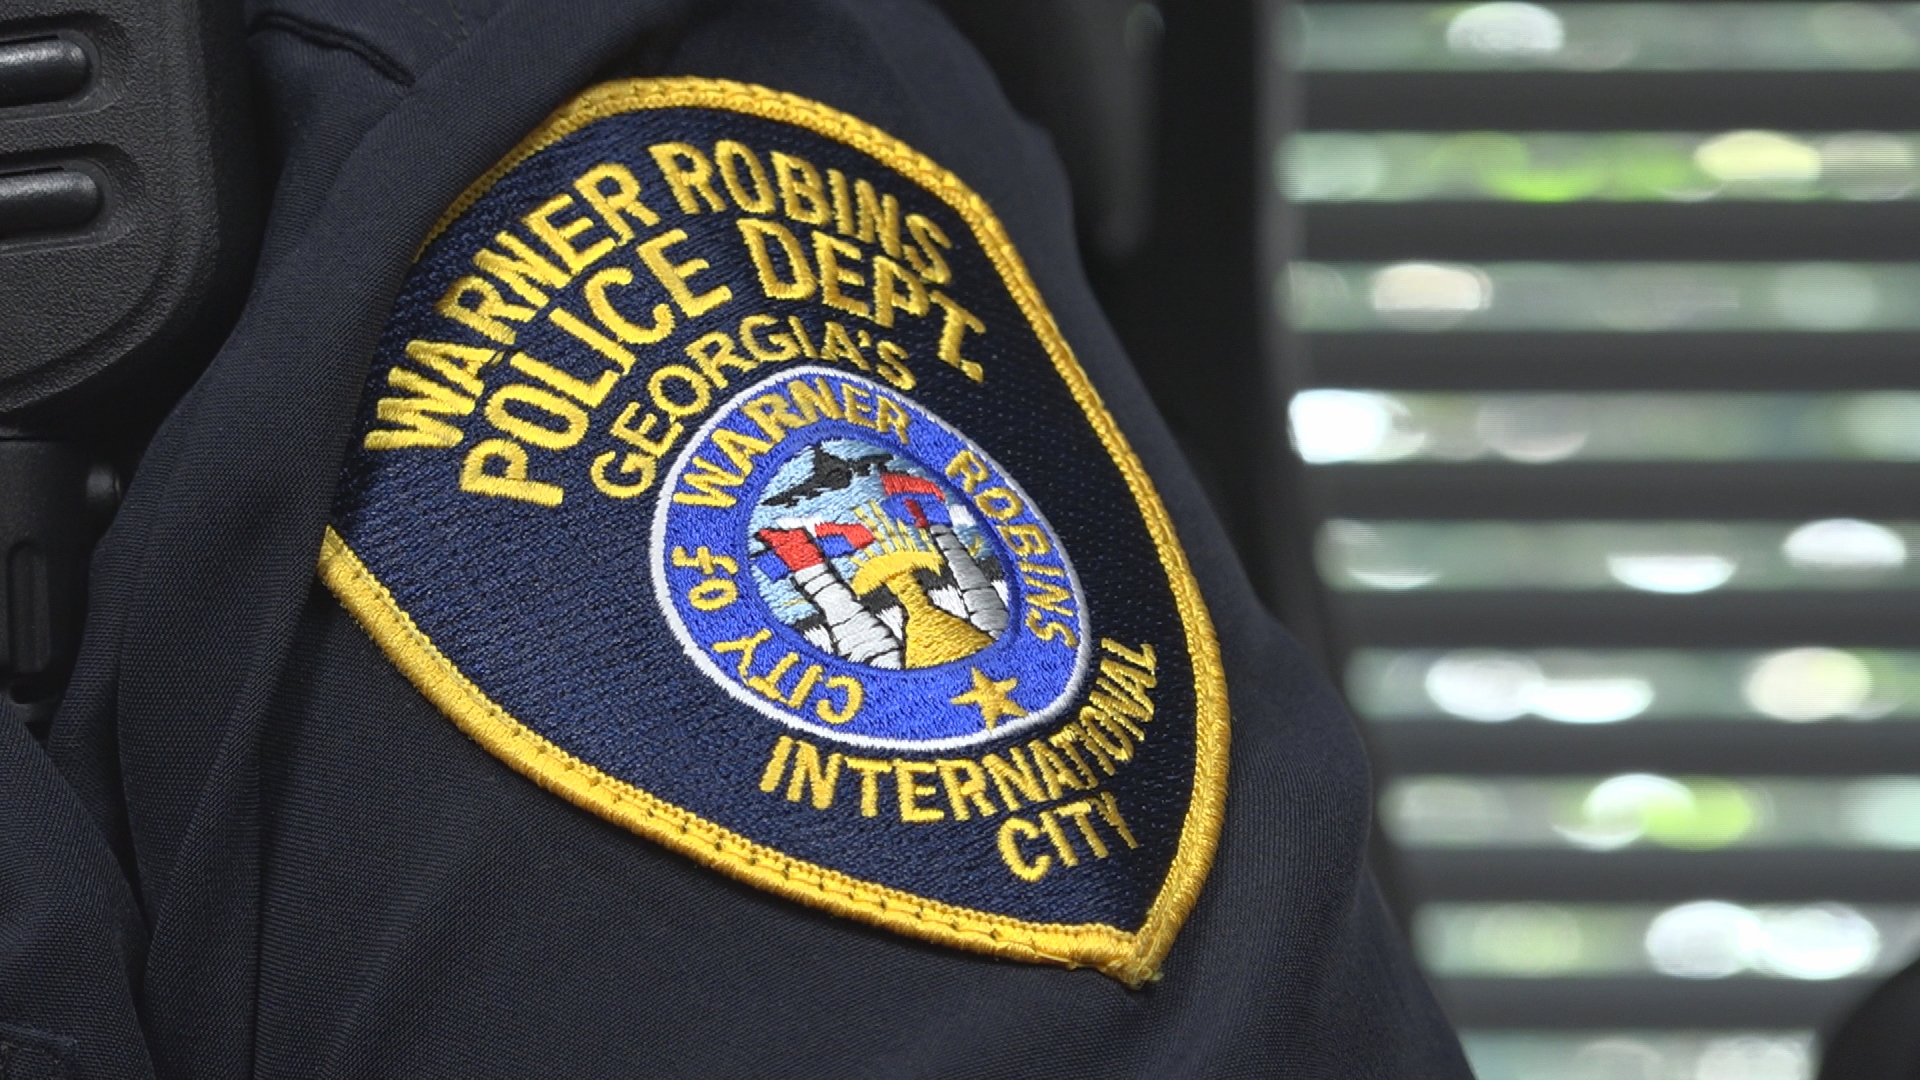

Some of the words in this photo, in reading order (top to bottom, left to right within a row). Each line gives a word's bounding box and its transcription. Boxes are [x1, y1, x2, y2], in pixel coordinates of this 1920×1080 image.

[364, 162, 659, 451] WARNER
[648, 140, 953, 285] ROBINS
[459, 228, 733, 506] POLICE
[737, 218, 986, 383] DEPT.
[590, 313, 917, 499] GEORGIA'S
[673, 377, 913, 509] WARNER
[944, 450, 1077, 648] ROBINS
[714, 628, 865, 725] CITY
[760, 637, 1158, 823] INTERNATIONAL
[998, 791, 1139, 883] CITY
